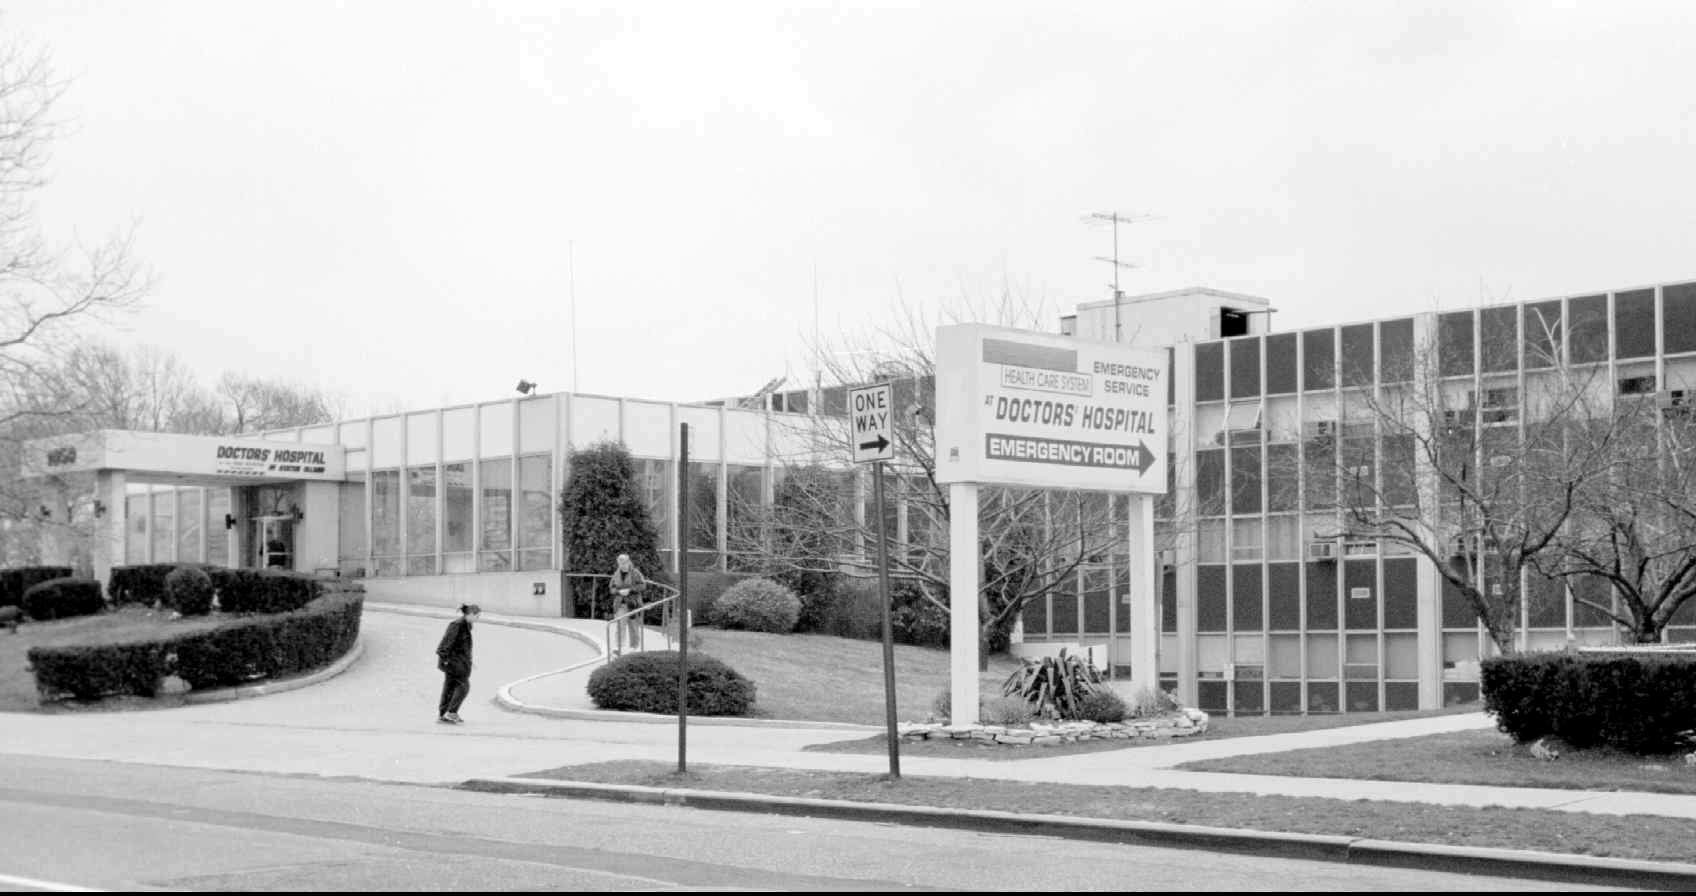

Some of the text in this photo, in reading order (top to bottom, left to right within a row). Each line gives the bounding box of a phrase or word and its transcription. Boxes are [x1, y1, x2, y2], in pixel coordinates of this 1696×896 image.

[1004, 367, 1091, 393] HEALTH CARE SYSTEM
[1093, 360, 1161, 381] EMERGENCY
[1104, 379, 1151, 398] SERVICE
[855, 390, 887, 412] ONE
[855, 412, 888, 432] WAY
[1082, 405, 1156, 435] HOSPITAL
[273, 449, 326, 465] HOSPITAL
[989, 437, 1140, 467] EMERGENCY ROOM
